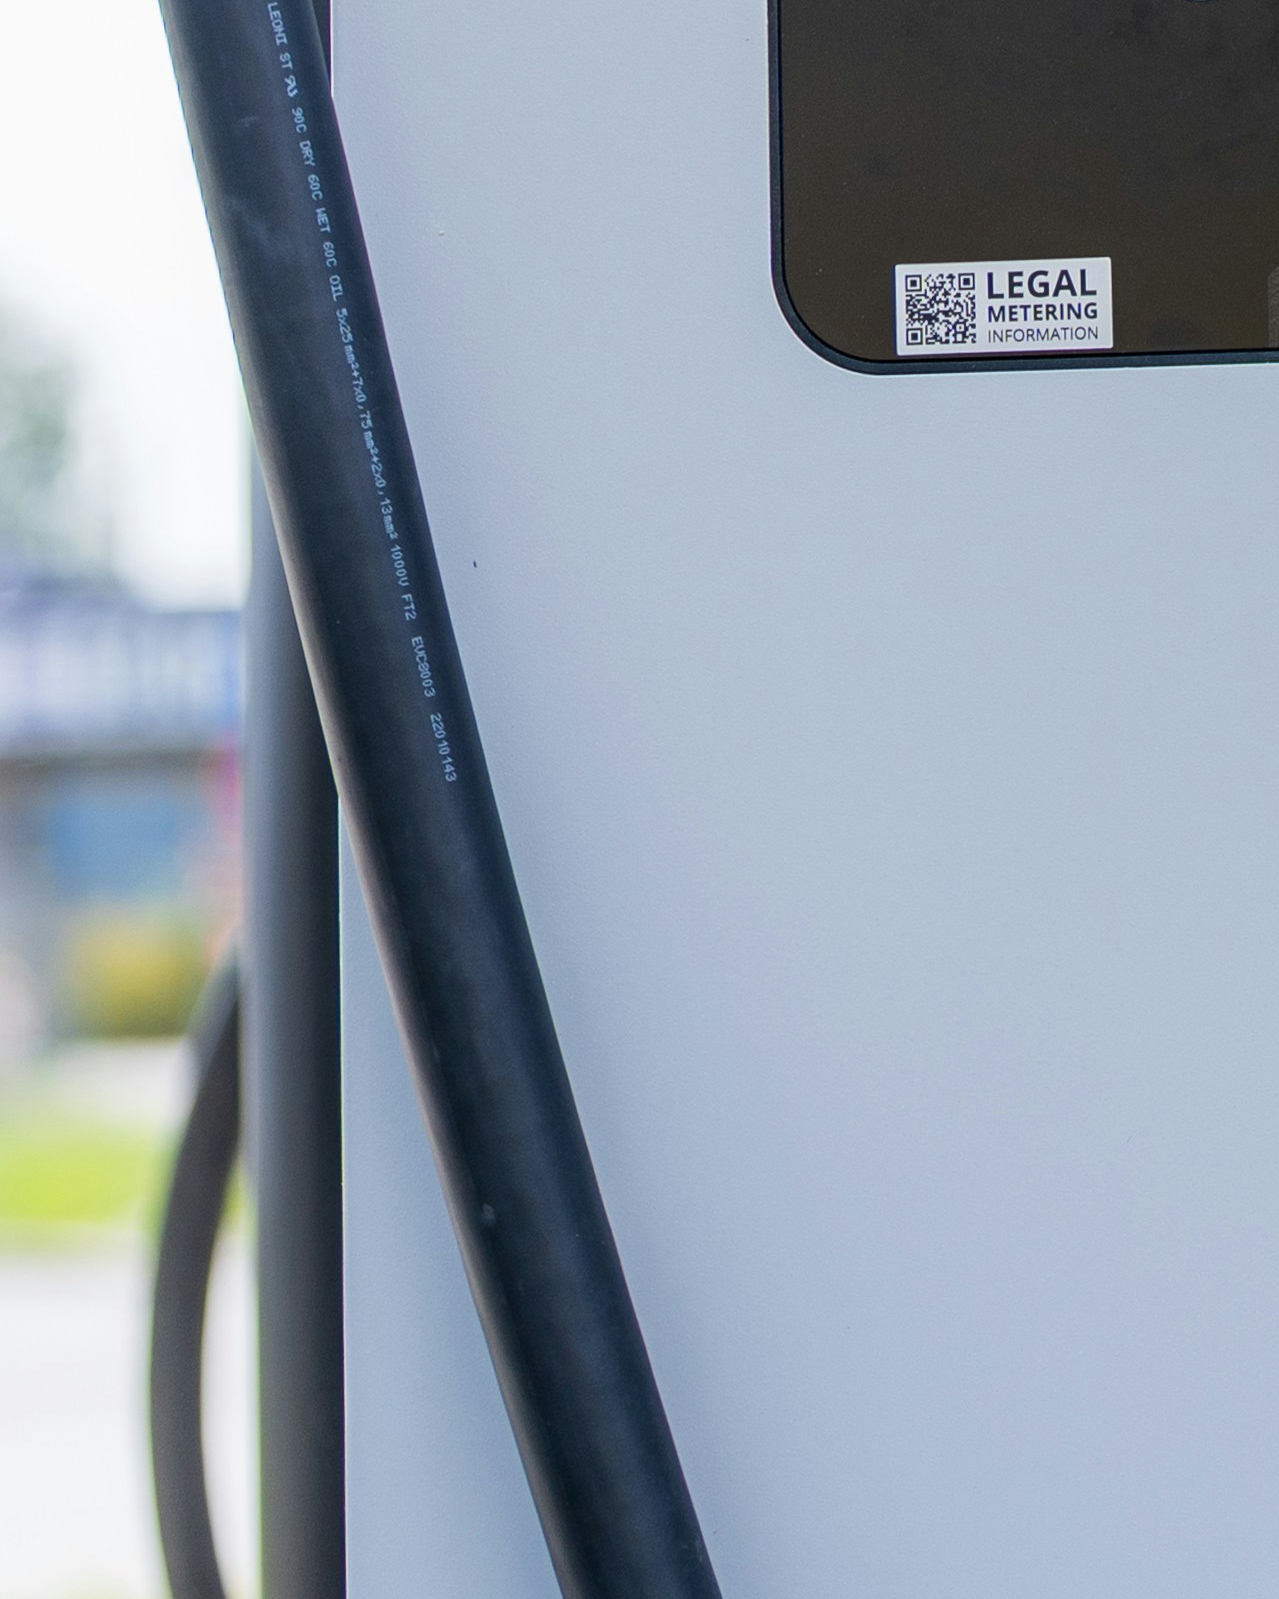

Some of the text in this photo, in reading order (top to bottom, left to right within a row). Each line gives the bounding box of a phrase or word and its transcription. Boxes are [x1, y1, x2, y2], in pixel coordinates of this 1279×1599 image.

[267, 1, 286, 47] LEONI
[279, 51, 292, 69] ST
[291, 106, 306, 134] 90C
[299, 140, 314, 166] DRY
[307, 173, 322, 201] 60C
[315, 207, 331, 233] WET
[322, 241, 337, 268] 60C
[329, 274, 343, 302] OIL
[986, 268, 1098, 300] LEGAL
[987, 301, 1099, 324] METERING
[987, 325, 1099, 344] INFORMATION
[390, 544, 409, 587] 1000V
[401, 593, 417, 621] FT2
[430, 713, 457, 782] 22010143
